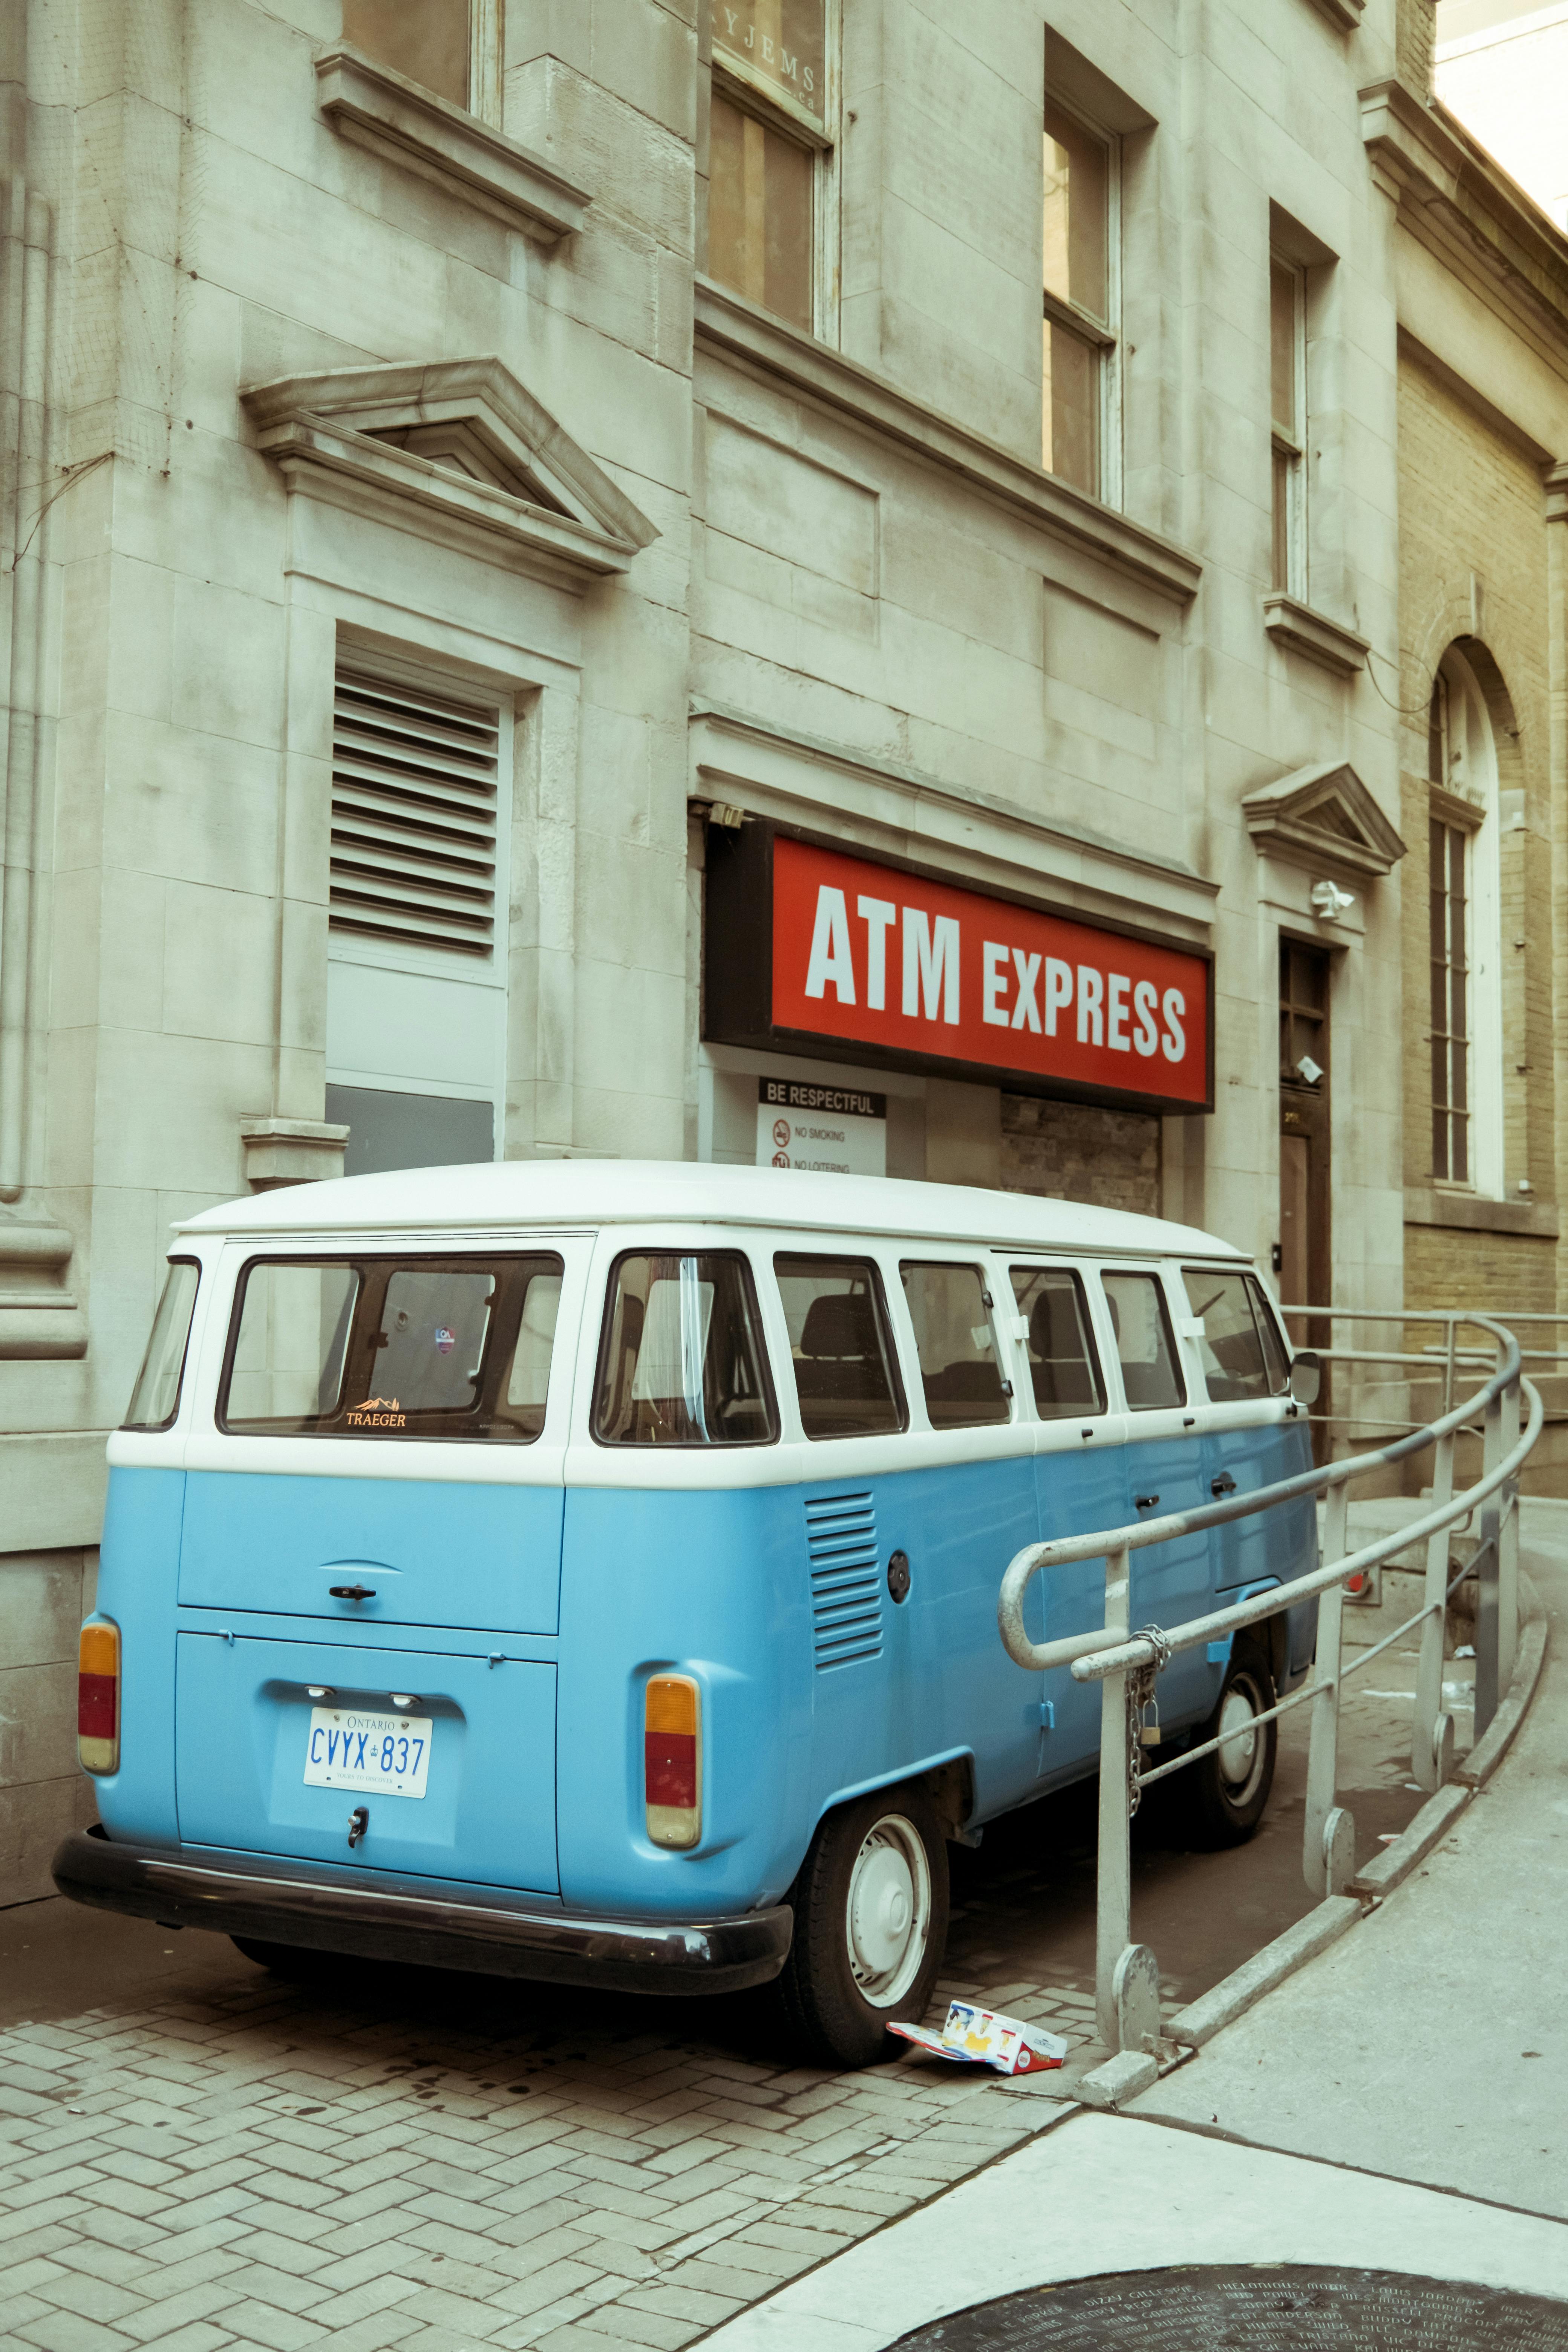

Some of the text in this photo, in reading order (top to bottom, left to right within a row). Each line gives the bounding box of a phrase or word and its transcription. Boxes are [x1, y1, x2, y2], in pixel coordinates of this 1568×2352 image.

[804, 885, 1186, 1063] ATM EXPRESS
[767, 1083, 874, 1114] BE RESPECTFUL
[795, 1127, 845, 1142] NO SMOKING
[795, 1160, 850, 1174] NO LOITERING
[346, 1412, 406, 1427] TRAEGER
[347, 1716, 395, 1732] ONTARIO
[311, 1728, 424, 1775] CVYX 837
[366, 1776, 392, 1784] DISCOVER
[1084, 2295, 1122, 2306] DIZZY
[1372, 2286, 1411, 2296] LOUIS
[1418, 2292, 1476, 2306] JORDAN
[1004, 2320, 1062, 2341] WILLIAMS
[1071, 2306, 1115, 2321] HENRY
[1380, 2297, 1485, 2315] MONTGOMERY
[1505, 2315, 1536, 2326] RAY
[1102, 2315, 1138, 2326] PAUL
[1363, 2305, 1422, 2316] RUSSELL
[1434, 2312, 1502, 2329] PROCOPE
[1361, 2314, 1411, 2324] BUDDY
[1423, 2321, 1458, 2332] TATE
[1239, 2332, 1290, 2341] LENNIE
[1297, 2332, 1368, 2341] TRISTANO
[1383, 2337, 1408, 2345] VIC
[1245, 2321, 1296, 2330] HUMES
[1404, 2329, 1469, 2344] DAVISON
